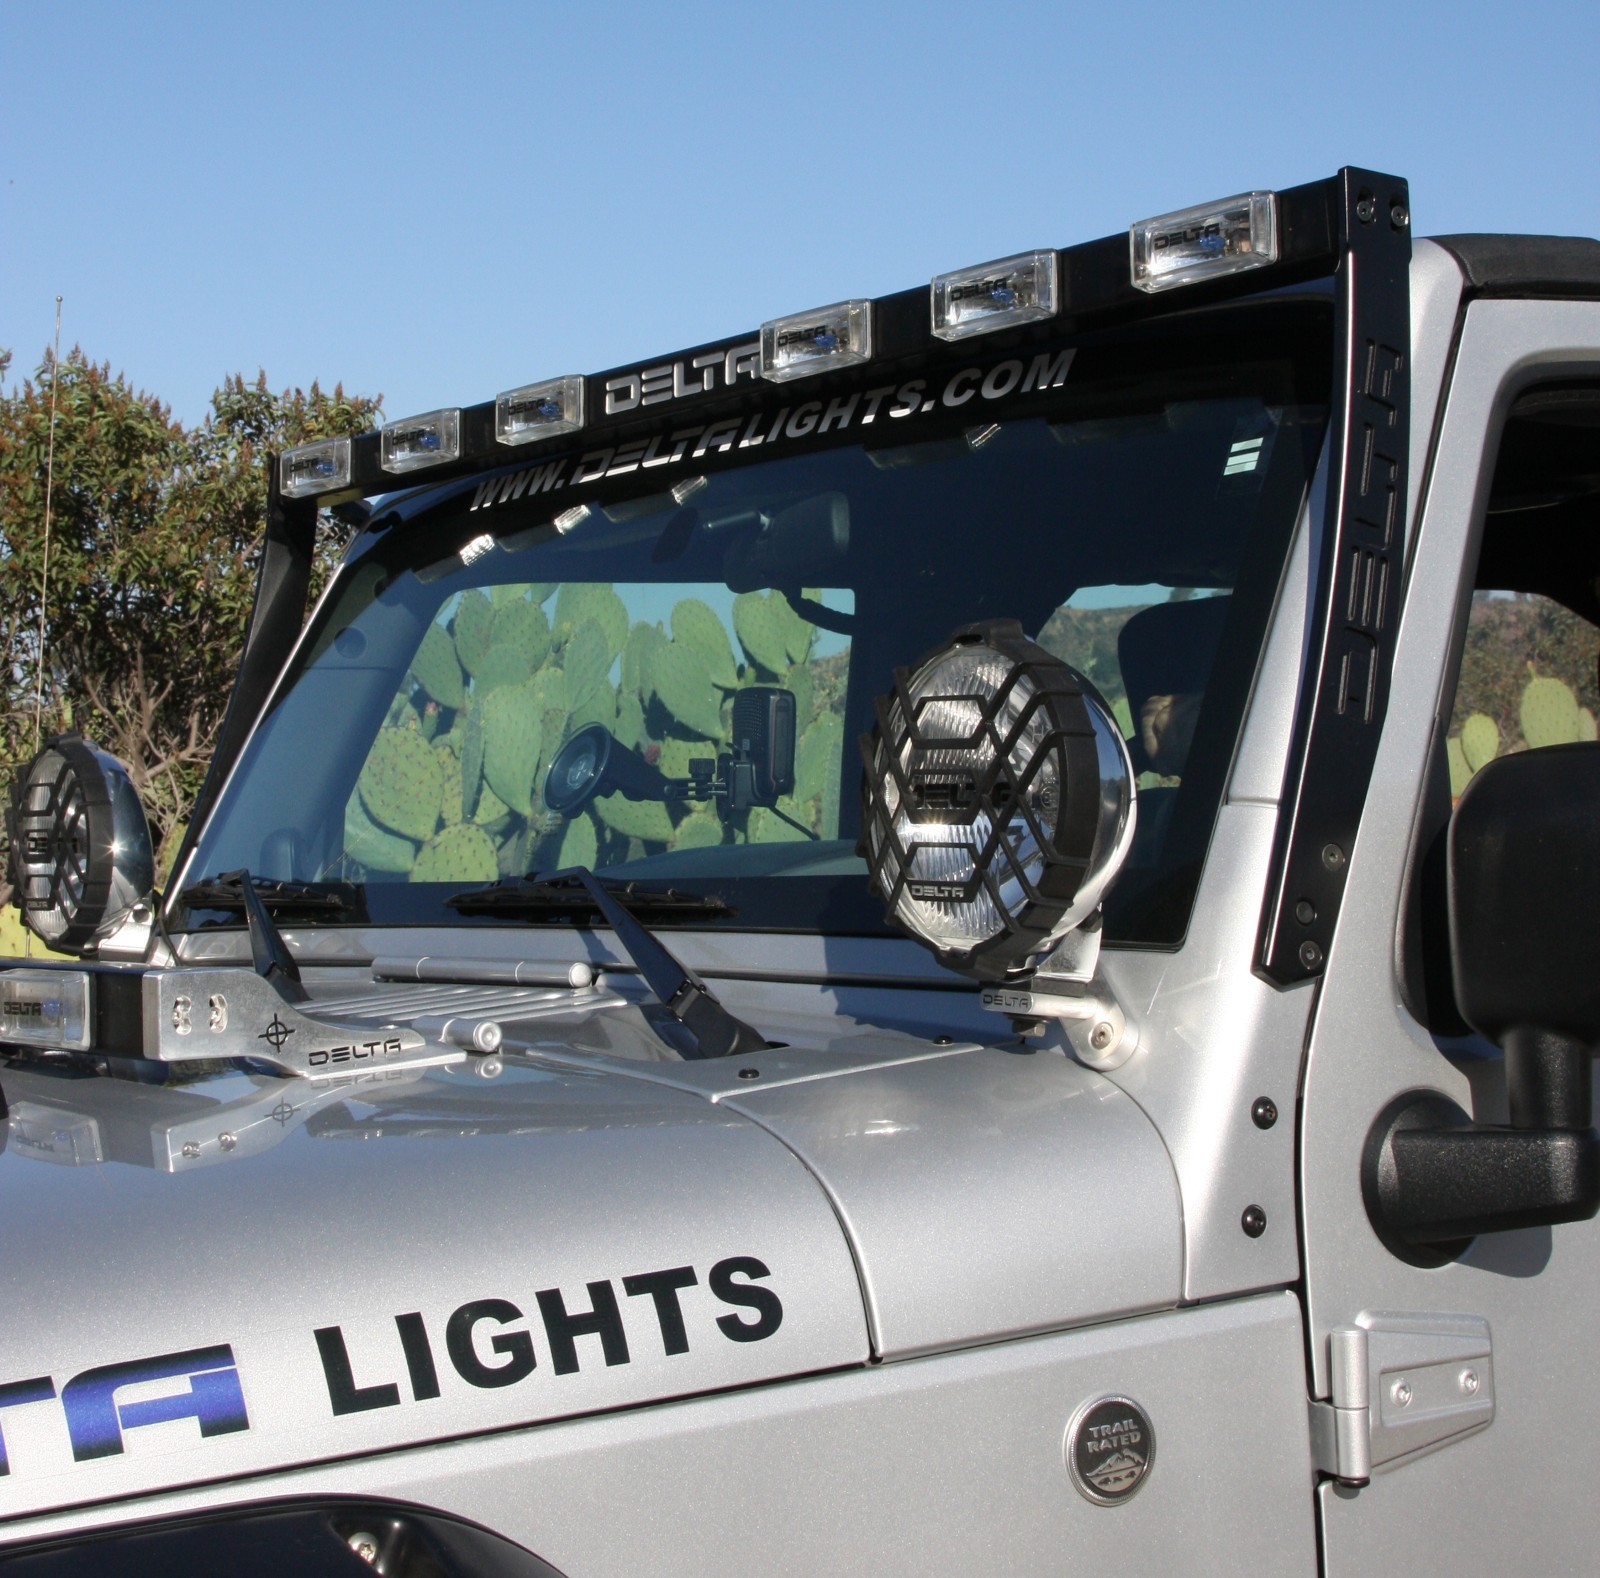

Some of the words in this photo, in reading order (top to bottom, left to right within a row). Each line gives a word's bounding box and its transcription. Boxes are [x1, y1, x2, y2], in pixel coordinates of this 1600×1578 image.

[1153, 223, 1220, 250] DELTA
[605, 342, 760, 415] DELTA
[911, 884, 965, 898] DELTA
[4, 1001, 42, 1016] DELTA
[982, 994, 1028, 1008] DELTA
[308, 1038, 402, 1067] DELTA
[313, 1255, 784, 1417] LIGHTS
[1088, 1418, 1138, 1439] TRAIL
[1086, 1431, 1142, 1454] RATED
